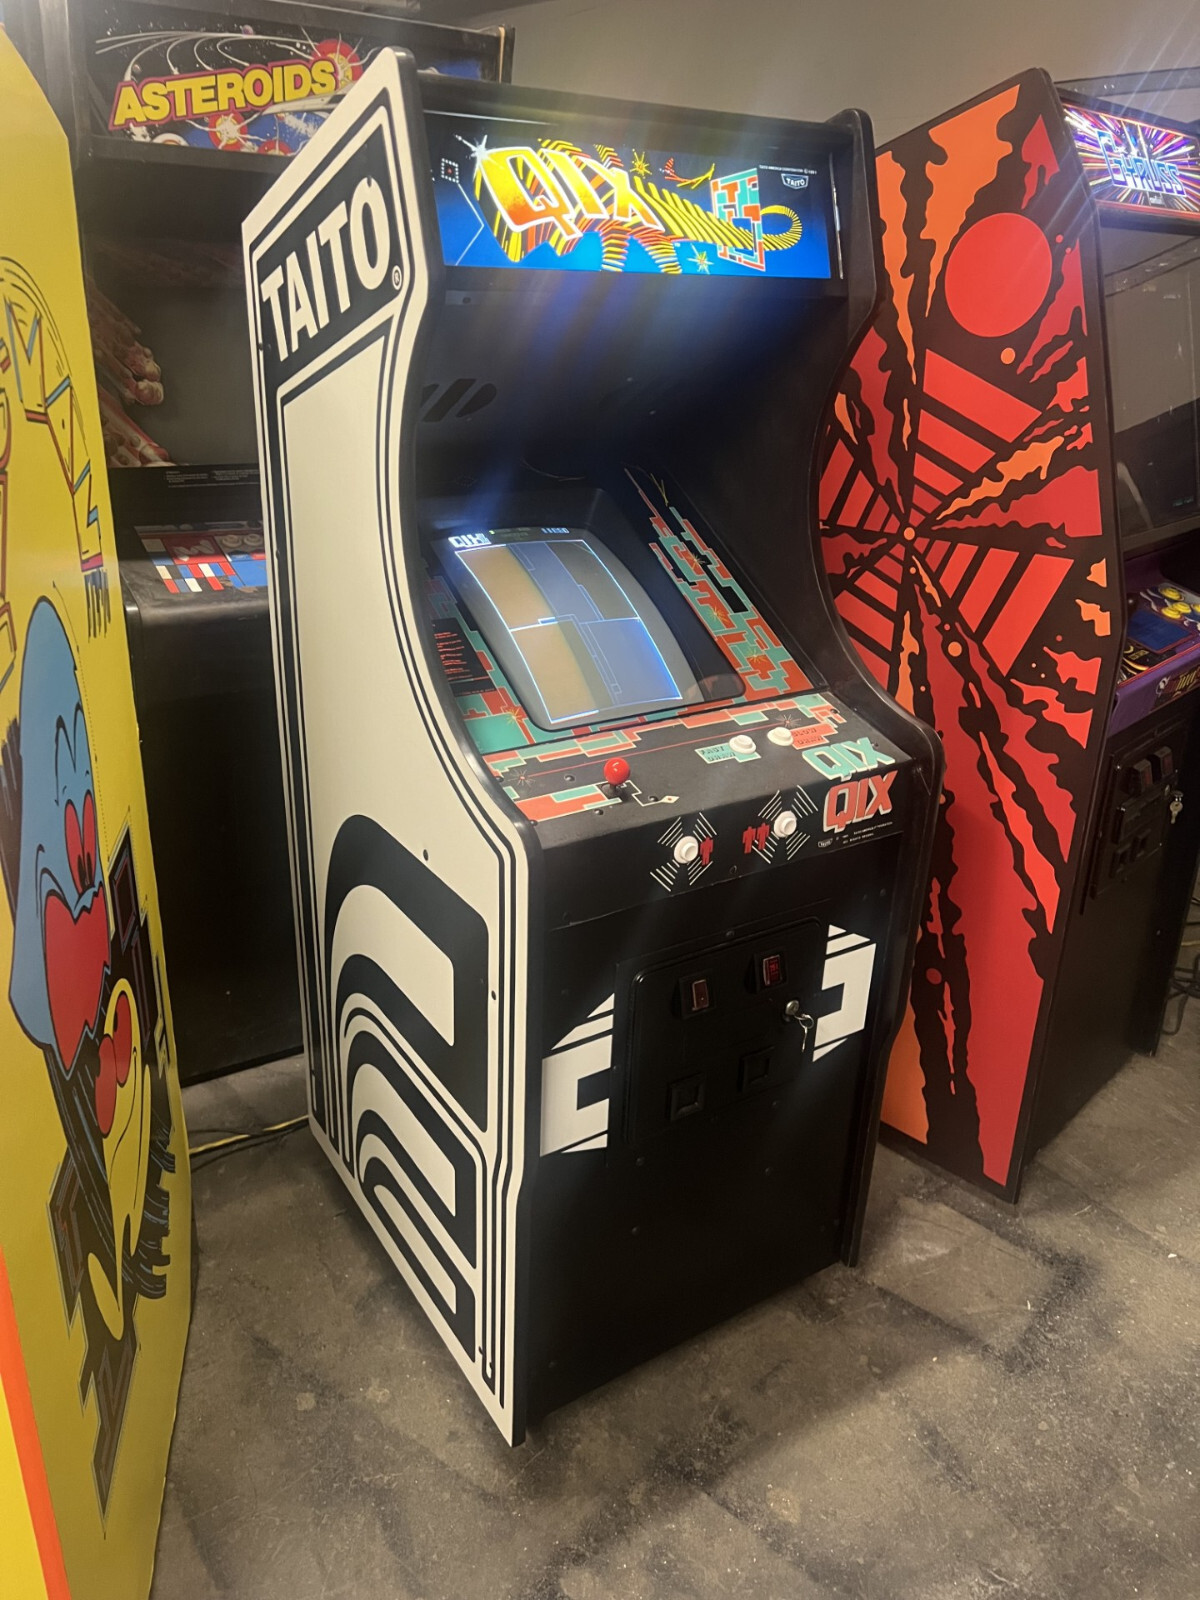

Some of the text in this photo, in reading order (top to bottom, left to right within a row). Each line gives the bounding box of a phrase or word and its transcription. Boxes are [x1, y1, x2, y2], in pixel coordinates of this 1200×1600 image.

[112, 59, 338, 127] ASTEROIDS
[478, 145, 666, 241] QIX
[786, 177, 806, 188] TAITO
[260, 177, 391, 362] TAITO
[802, 737, 896, 781] QIX
[823, 770, 898, 833] QIX
